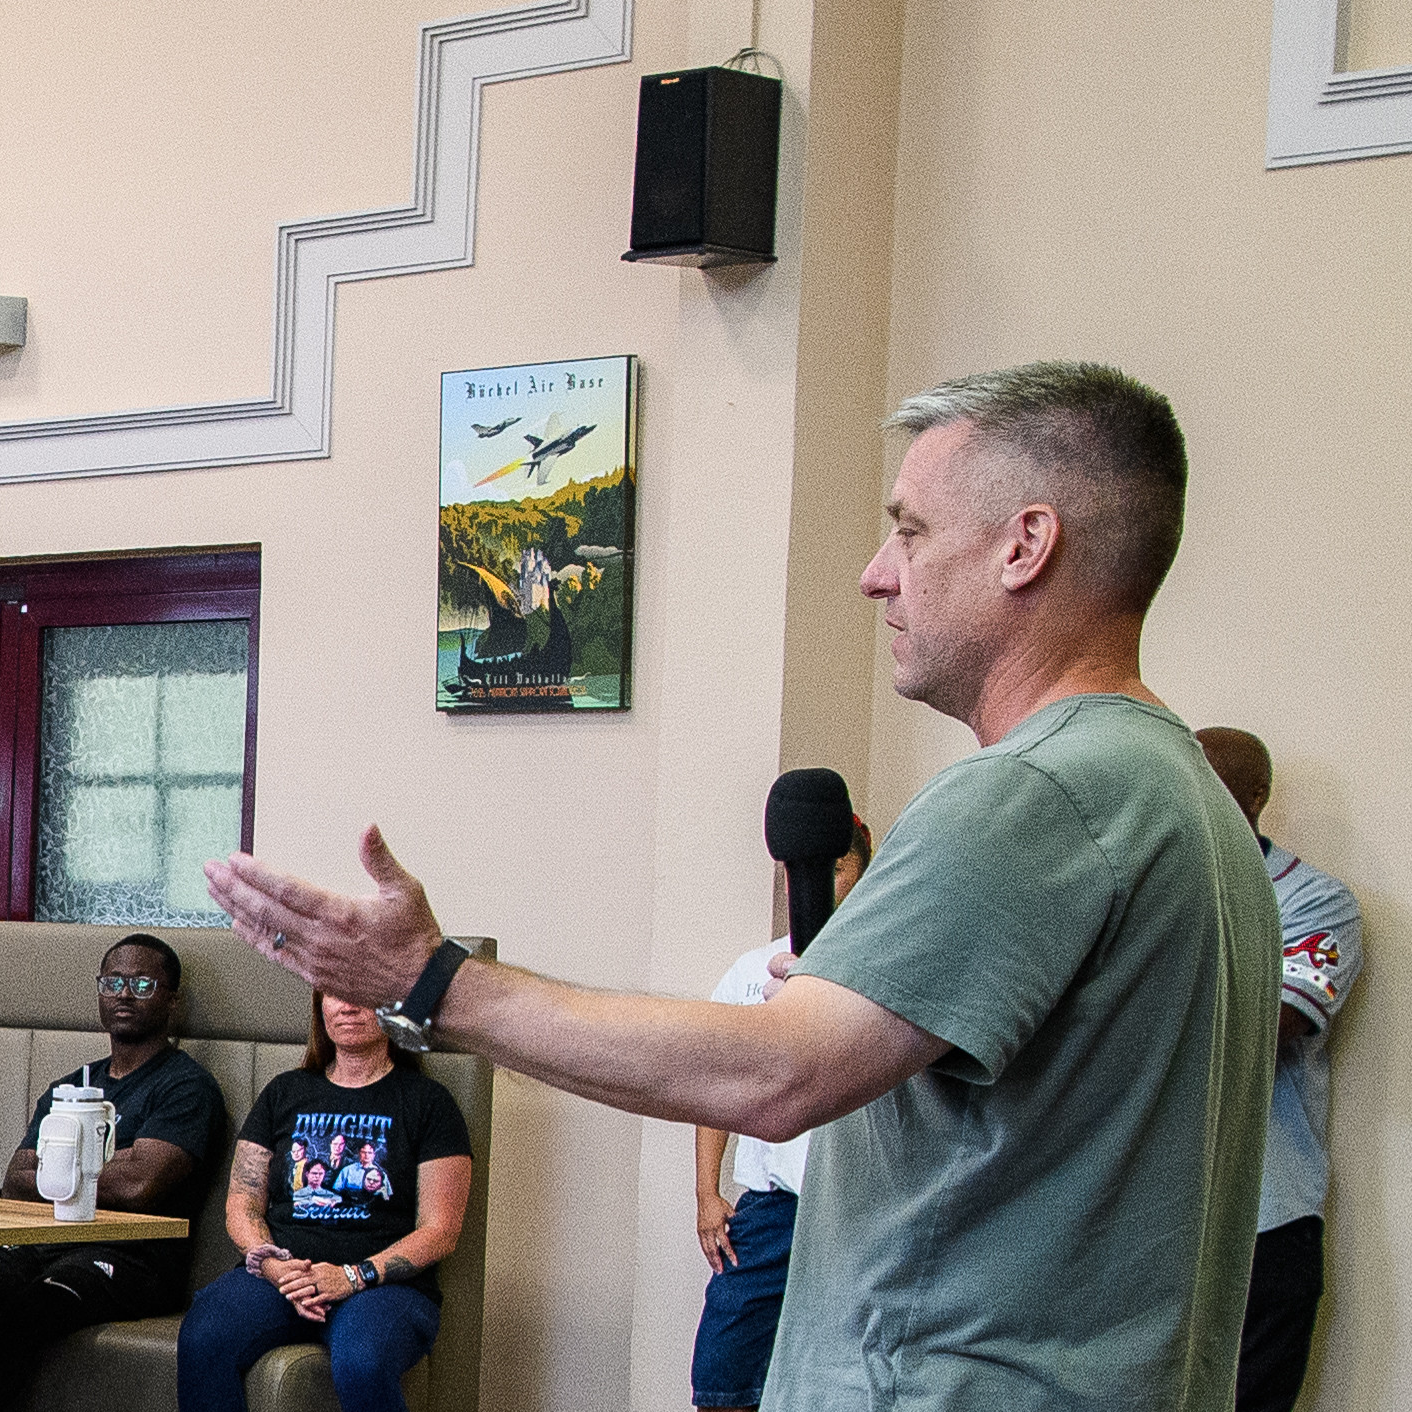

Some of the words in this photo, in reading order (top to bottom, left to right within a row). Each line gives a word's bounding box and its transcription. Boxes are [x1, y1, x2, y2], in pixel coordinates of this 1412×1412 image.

[527, 375, 555, 394] Air
[565, 371, 604, 391] Base
[292, 1113, 393, 1143] DWIGHT
